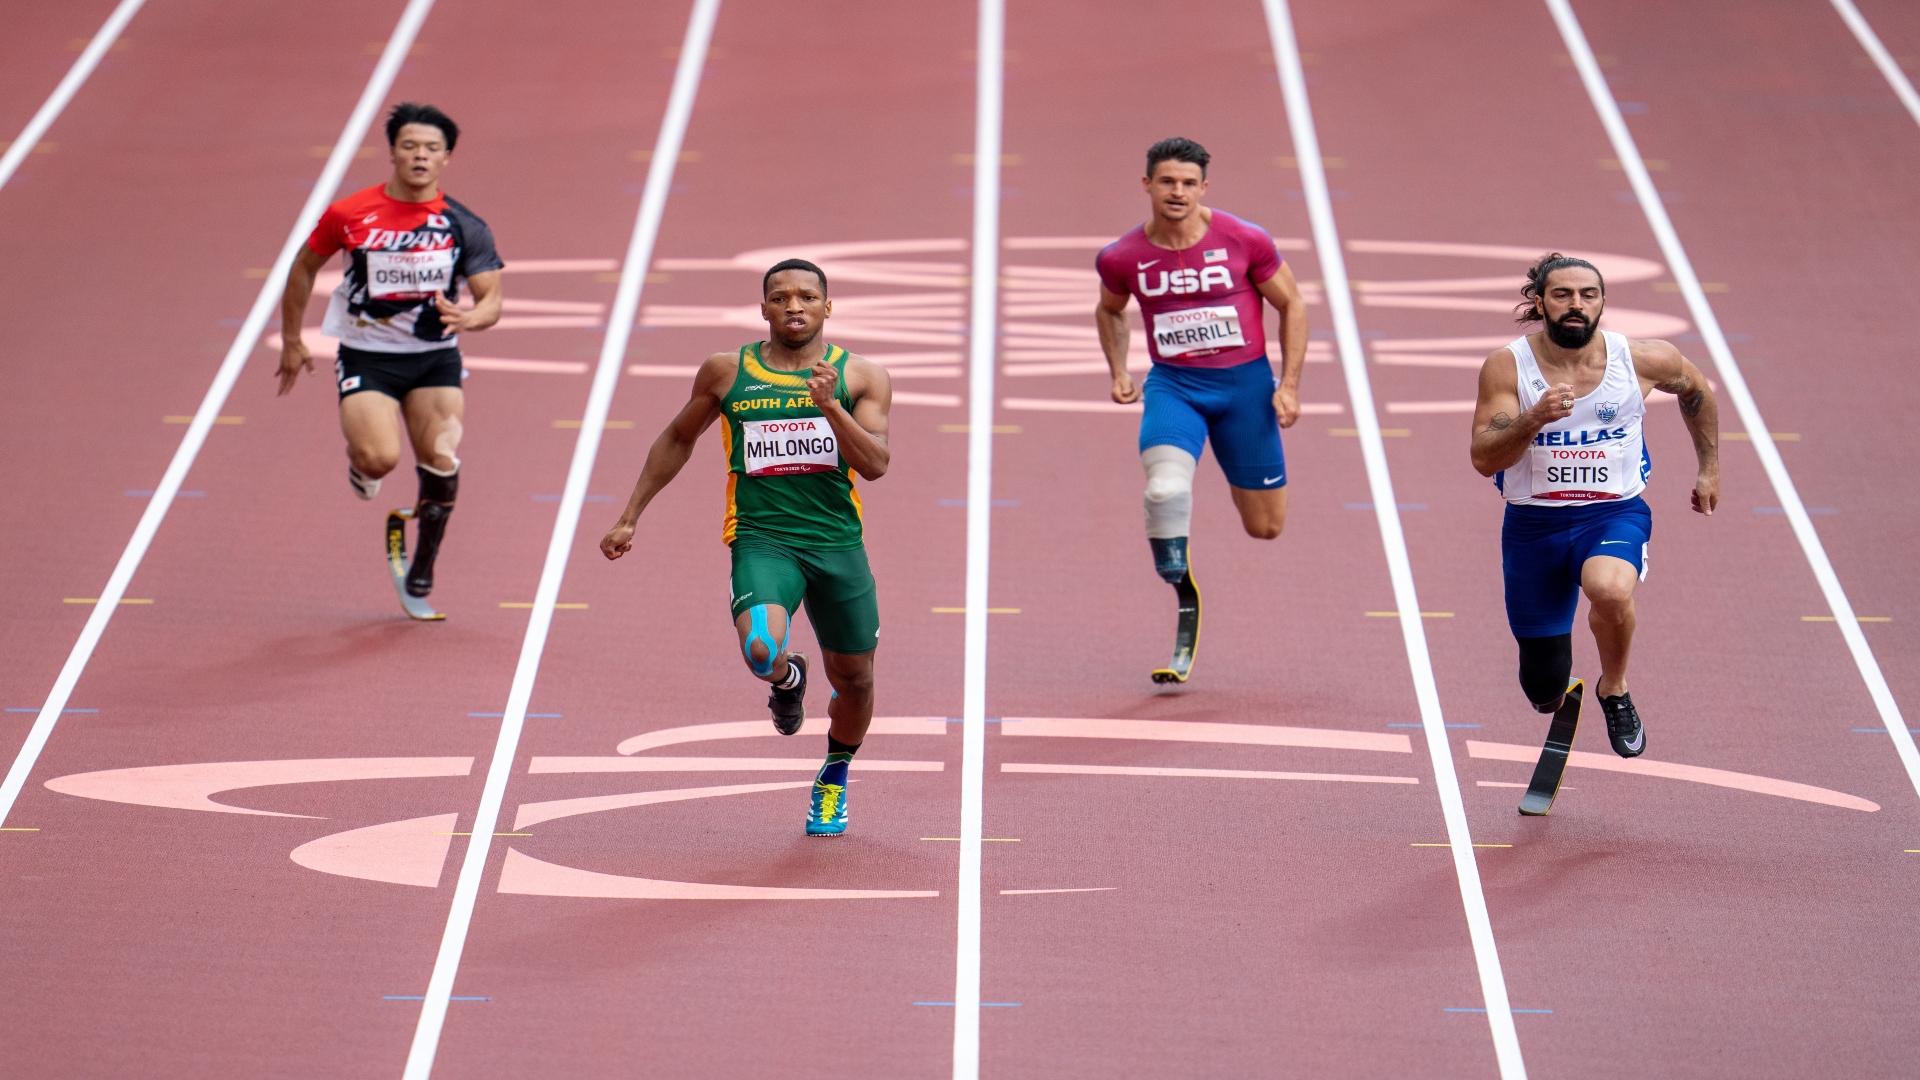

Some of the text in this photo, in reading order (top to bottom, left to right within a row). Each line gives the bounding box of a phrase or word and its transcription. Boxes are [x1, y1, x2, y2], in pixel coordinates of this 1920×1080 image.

[358, 227, 453, 250] JAPAN
[387, 254, 435, 265] TOYOTA
[375, 268, 444, 284] OSHIMA
[1137, 265, 1235, 297] USA
[1169, 310, 1219, 324] TOYOTA
[1158, 320, 1238, 346] MERRILL
[732, 398, 780, 413] SOUTH
[761, 421, 817, 434] TOYOTA
[1532, 427, 1627, 447] HELLAS
[747, 436, 835, 459] MHLONGO
[1551, 450, 1607, 460] TOYOTA
[1547, 466, 1609, 484] SEITIS
